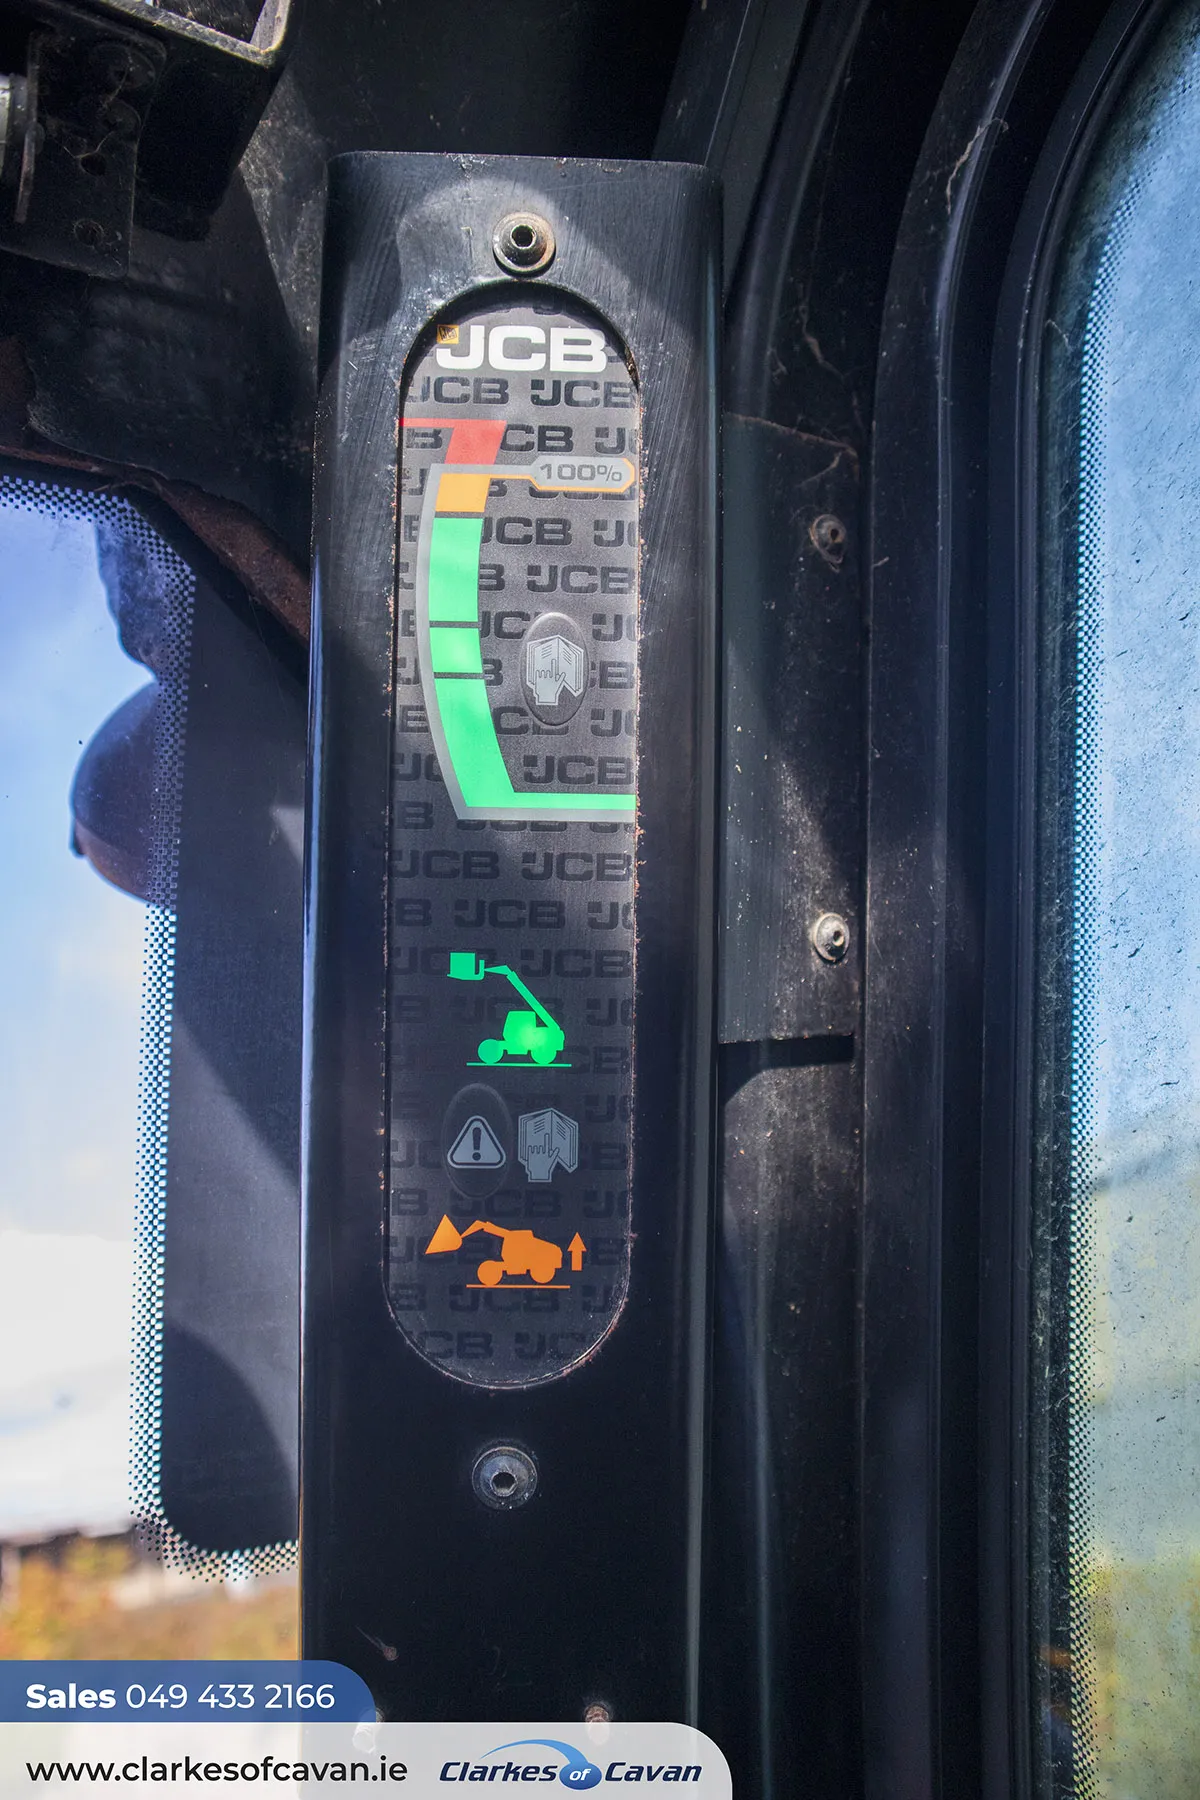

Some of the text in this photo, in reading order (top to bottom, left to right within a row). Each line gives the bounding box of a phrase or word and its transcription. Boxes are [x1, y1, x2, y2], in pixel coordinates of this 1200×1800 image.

[436, 325, 607, 373] JCB
[530, 379, 634, 409] JCB
[500, 424, 574, 453] CB
[540, 463, 623, 483] 100%
[527, 563, 637, 595] JCB
[523, 755, 637, 785] JCB
[391, 850, 500, 880] JCB
[521, 851, 635, 882] JCB
[452, 900, 566, 930] JCB
[520, 949, 632, 978] JCB
